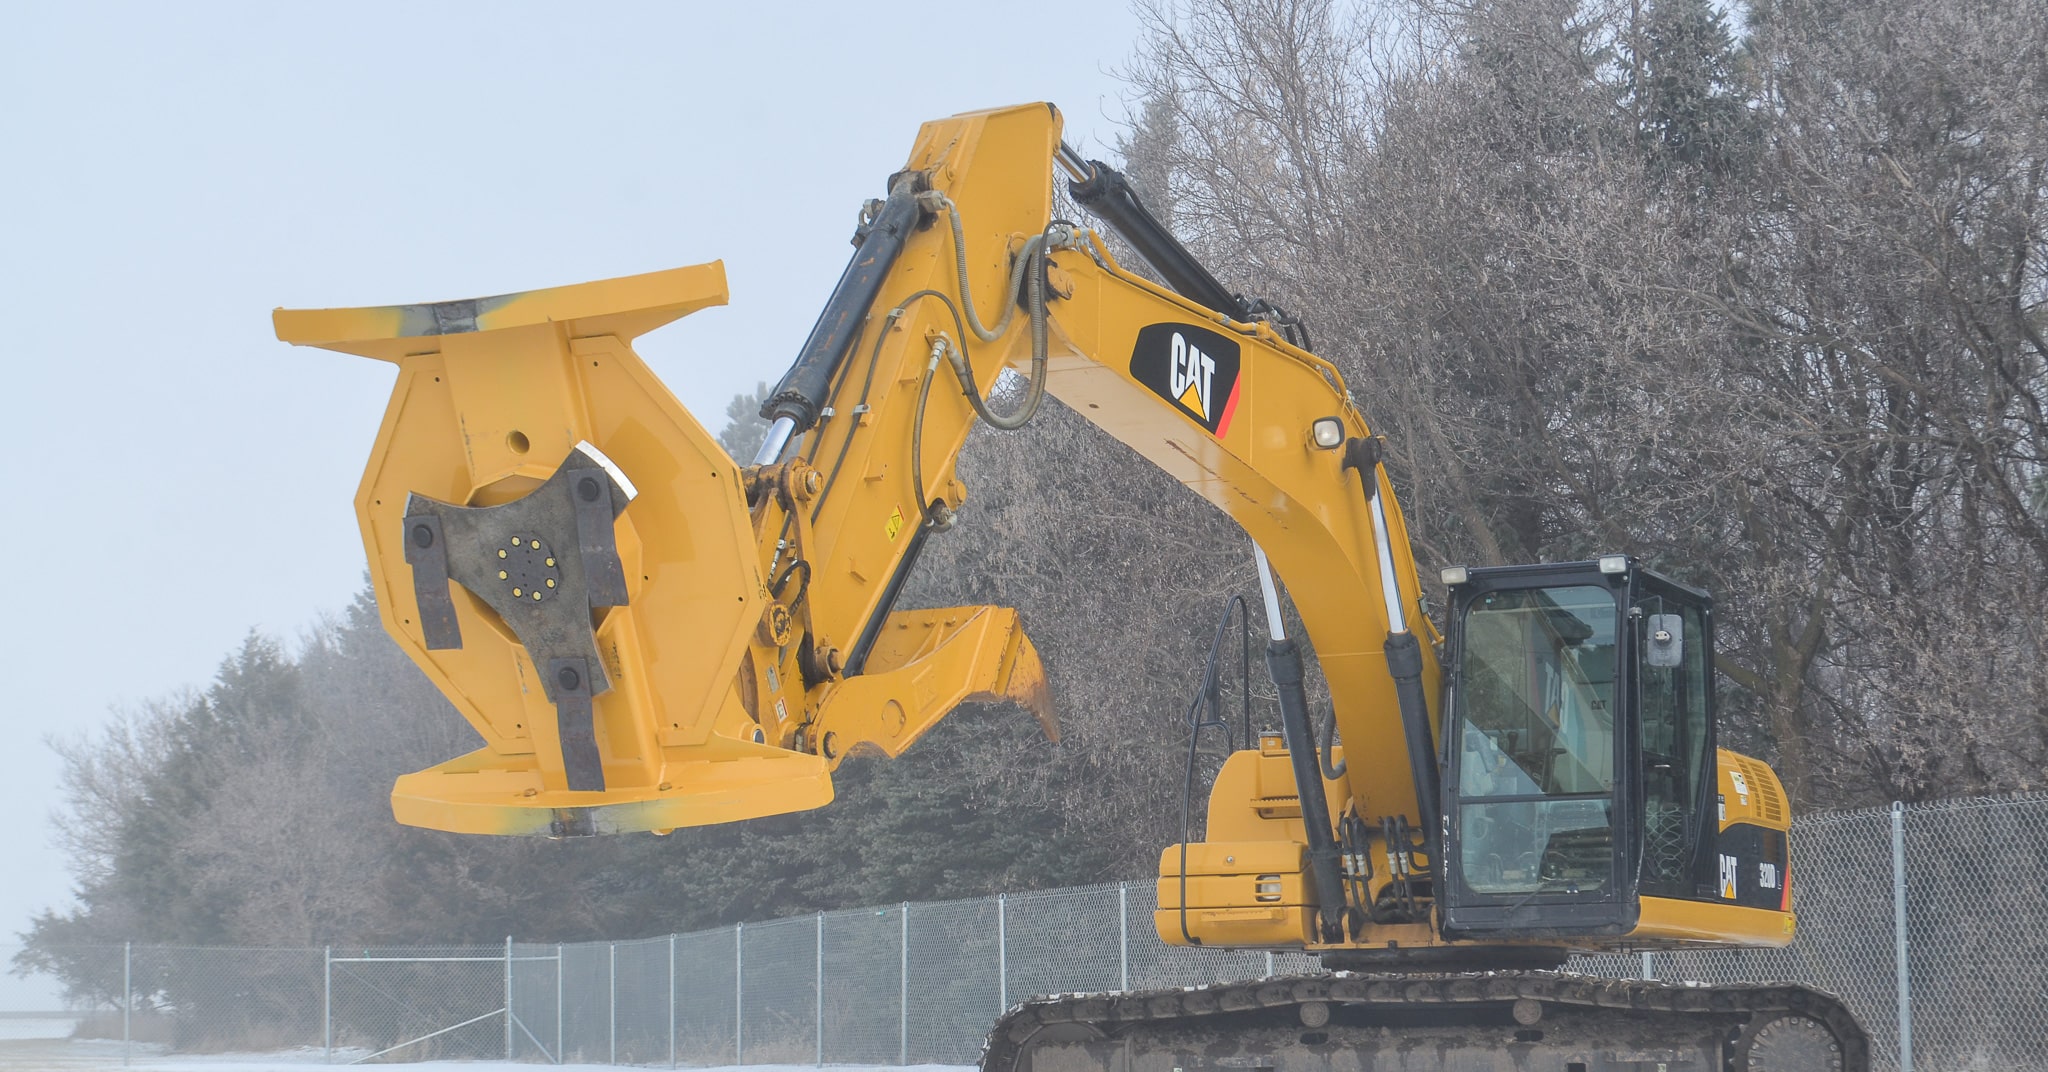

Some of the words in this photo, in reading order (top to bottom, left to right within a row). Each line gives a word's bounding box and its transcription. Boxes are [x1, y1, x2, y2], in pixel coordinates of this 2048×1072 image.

[1170, 332, 1215, 422] CAT
[1720, 854, 1737, 899] CAT
[1759, 862, 1776, 888] 320D
